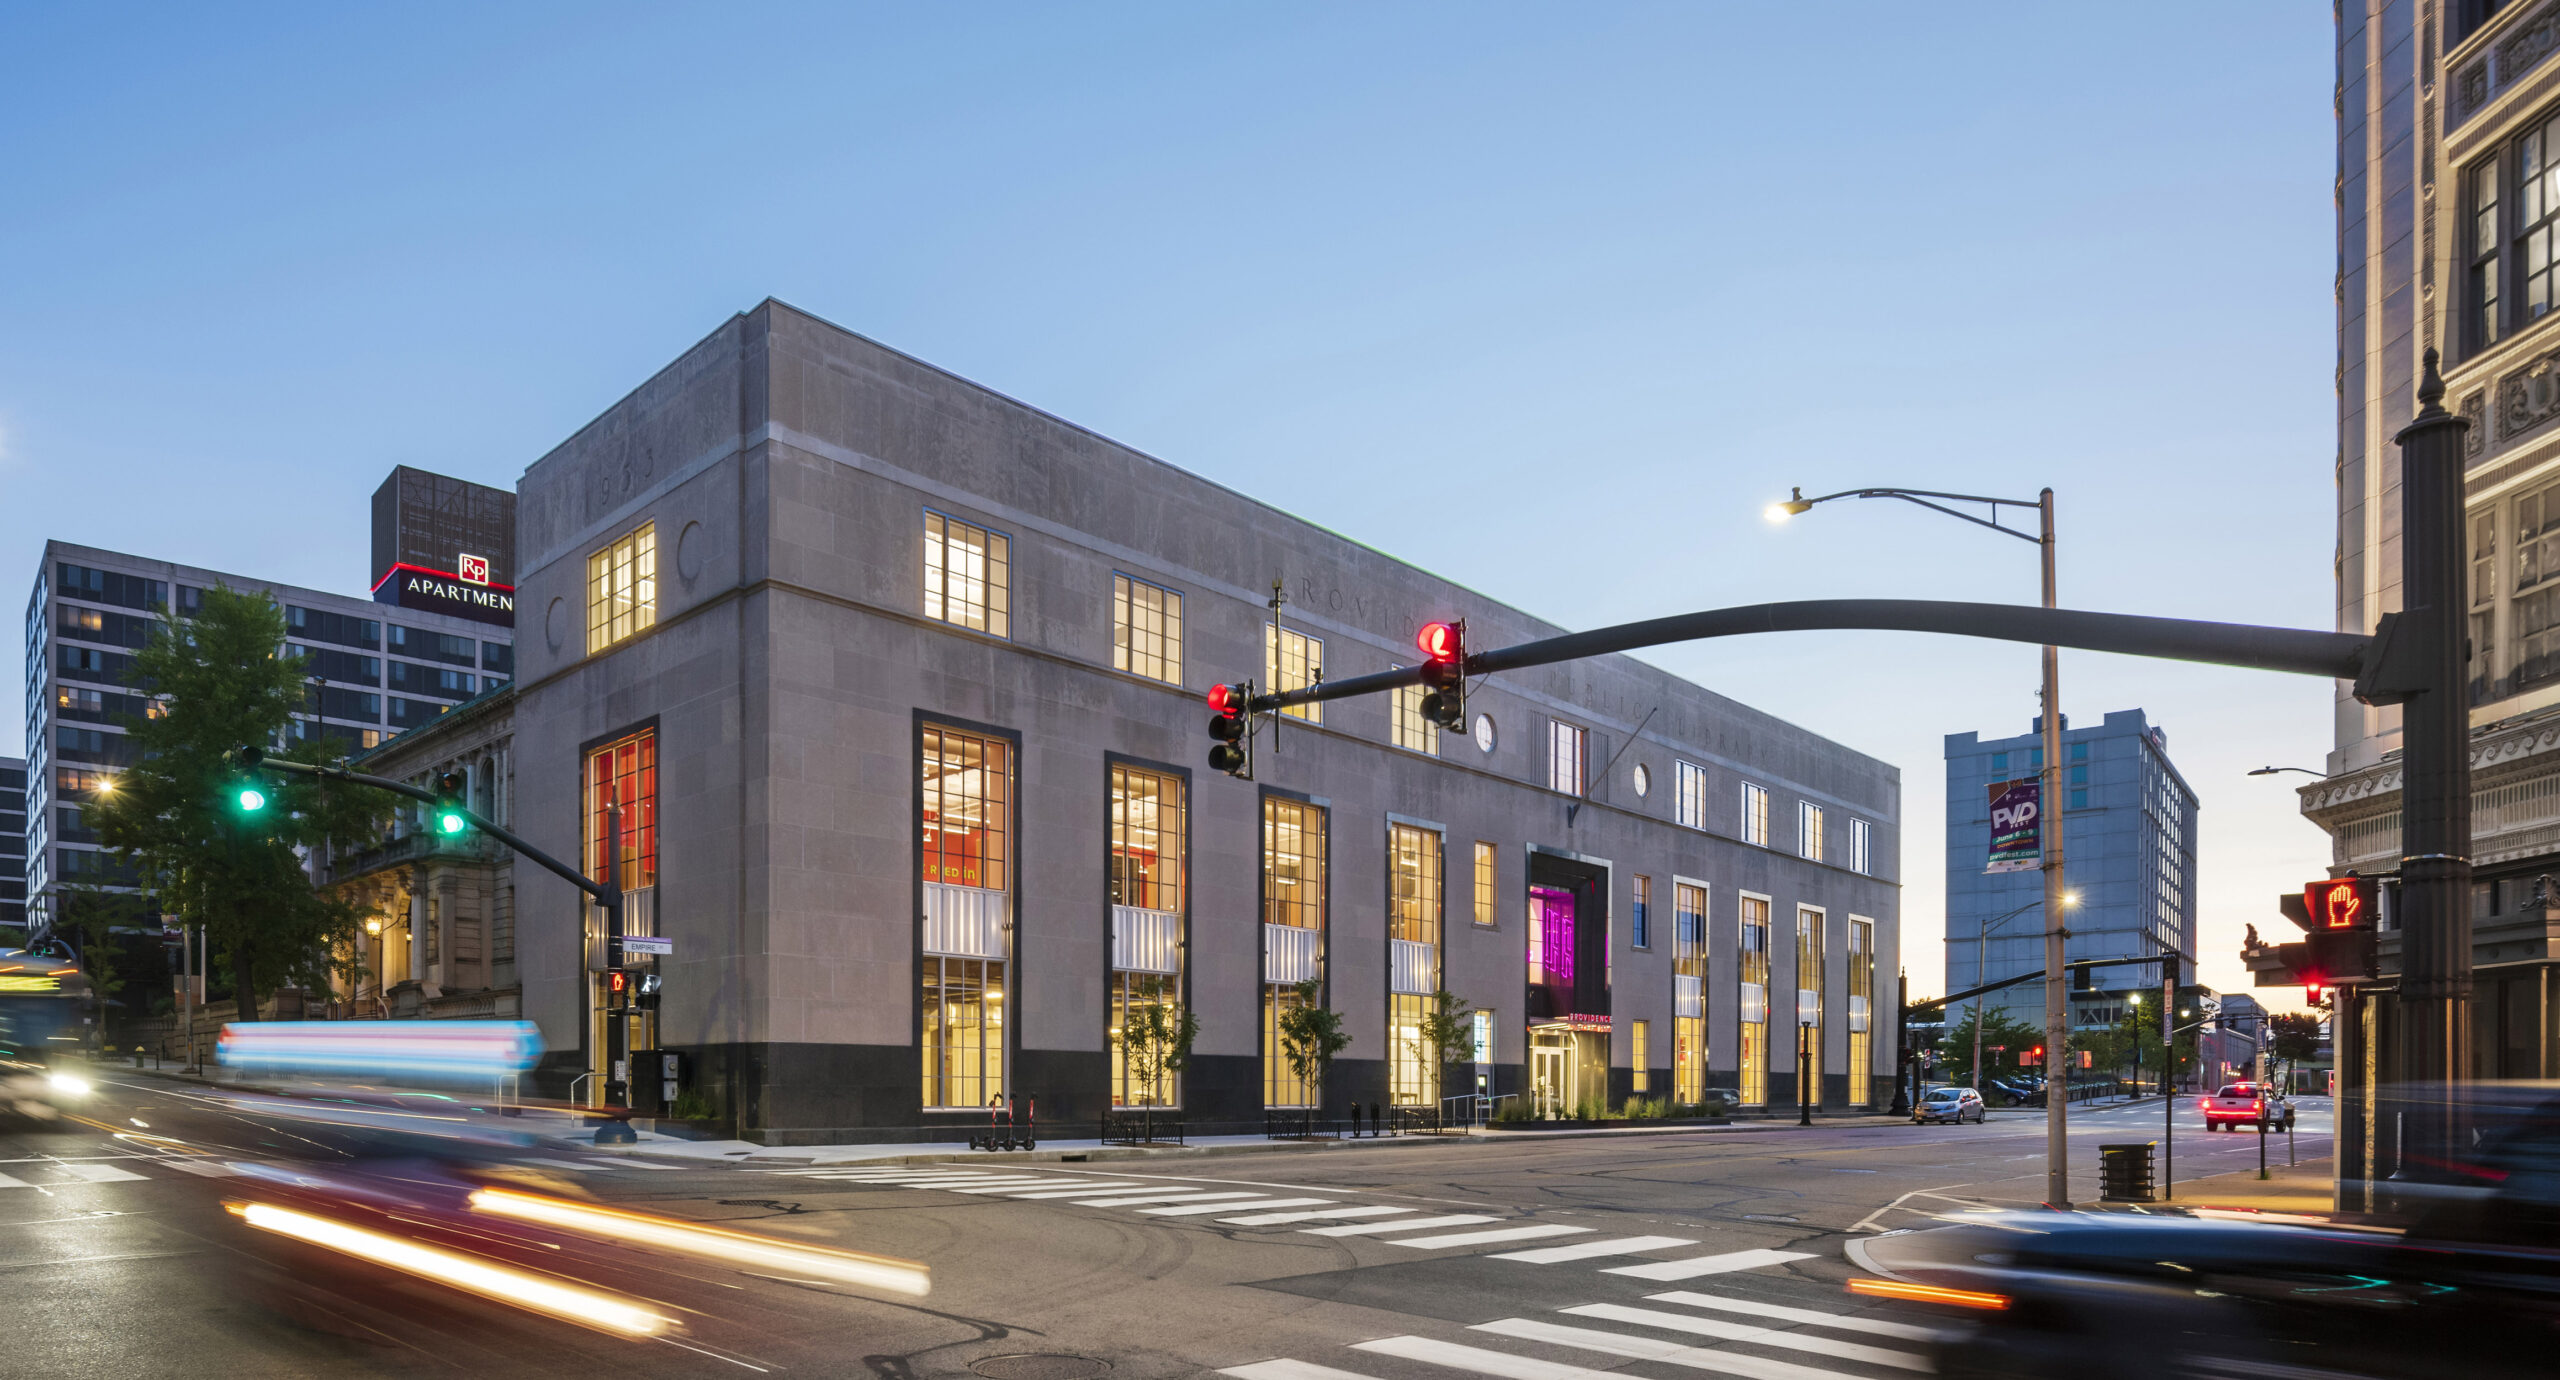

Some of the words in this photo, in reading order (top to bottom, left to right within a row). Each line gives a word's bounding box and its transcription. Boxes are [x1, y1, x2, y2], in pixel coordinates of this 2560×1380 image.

[408, 578, 513, 611] APARTMEN
[1992, 802, 2037, 829] PVD
[1996, 833, 2013, 842] June
[1997, 838, 2033, 848] DOWNTOWN
[1990, 850, 2038, 861] pvdfest.com
[930, 865, 959, 877] RED
[631, 943, 656, 951] EMPIRE
[1569, 1013, 1613, 1023] PROVIDENCE
